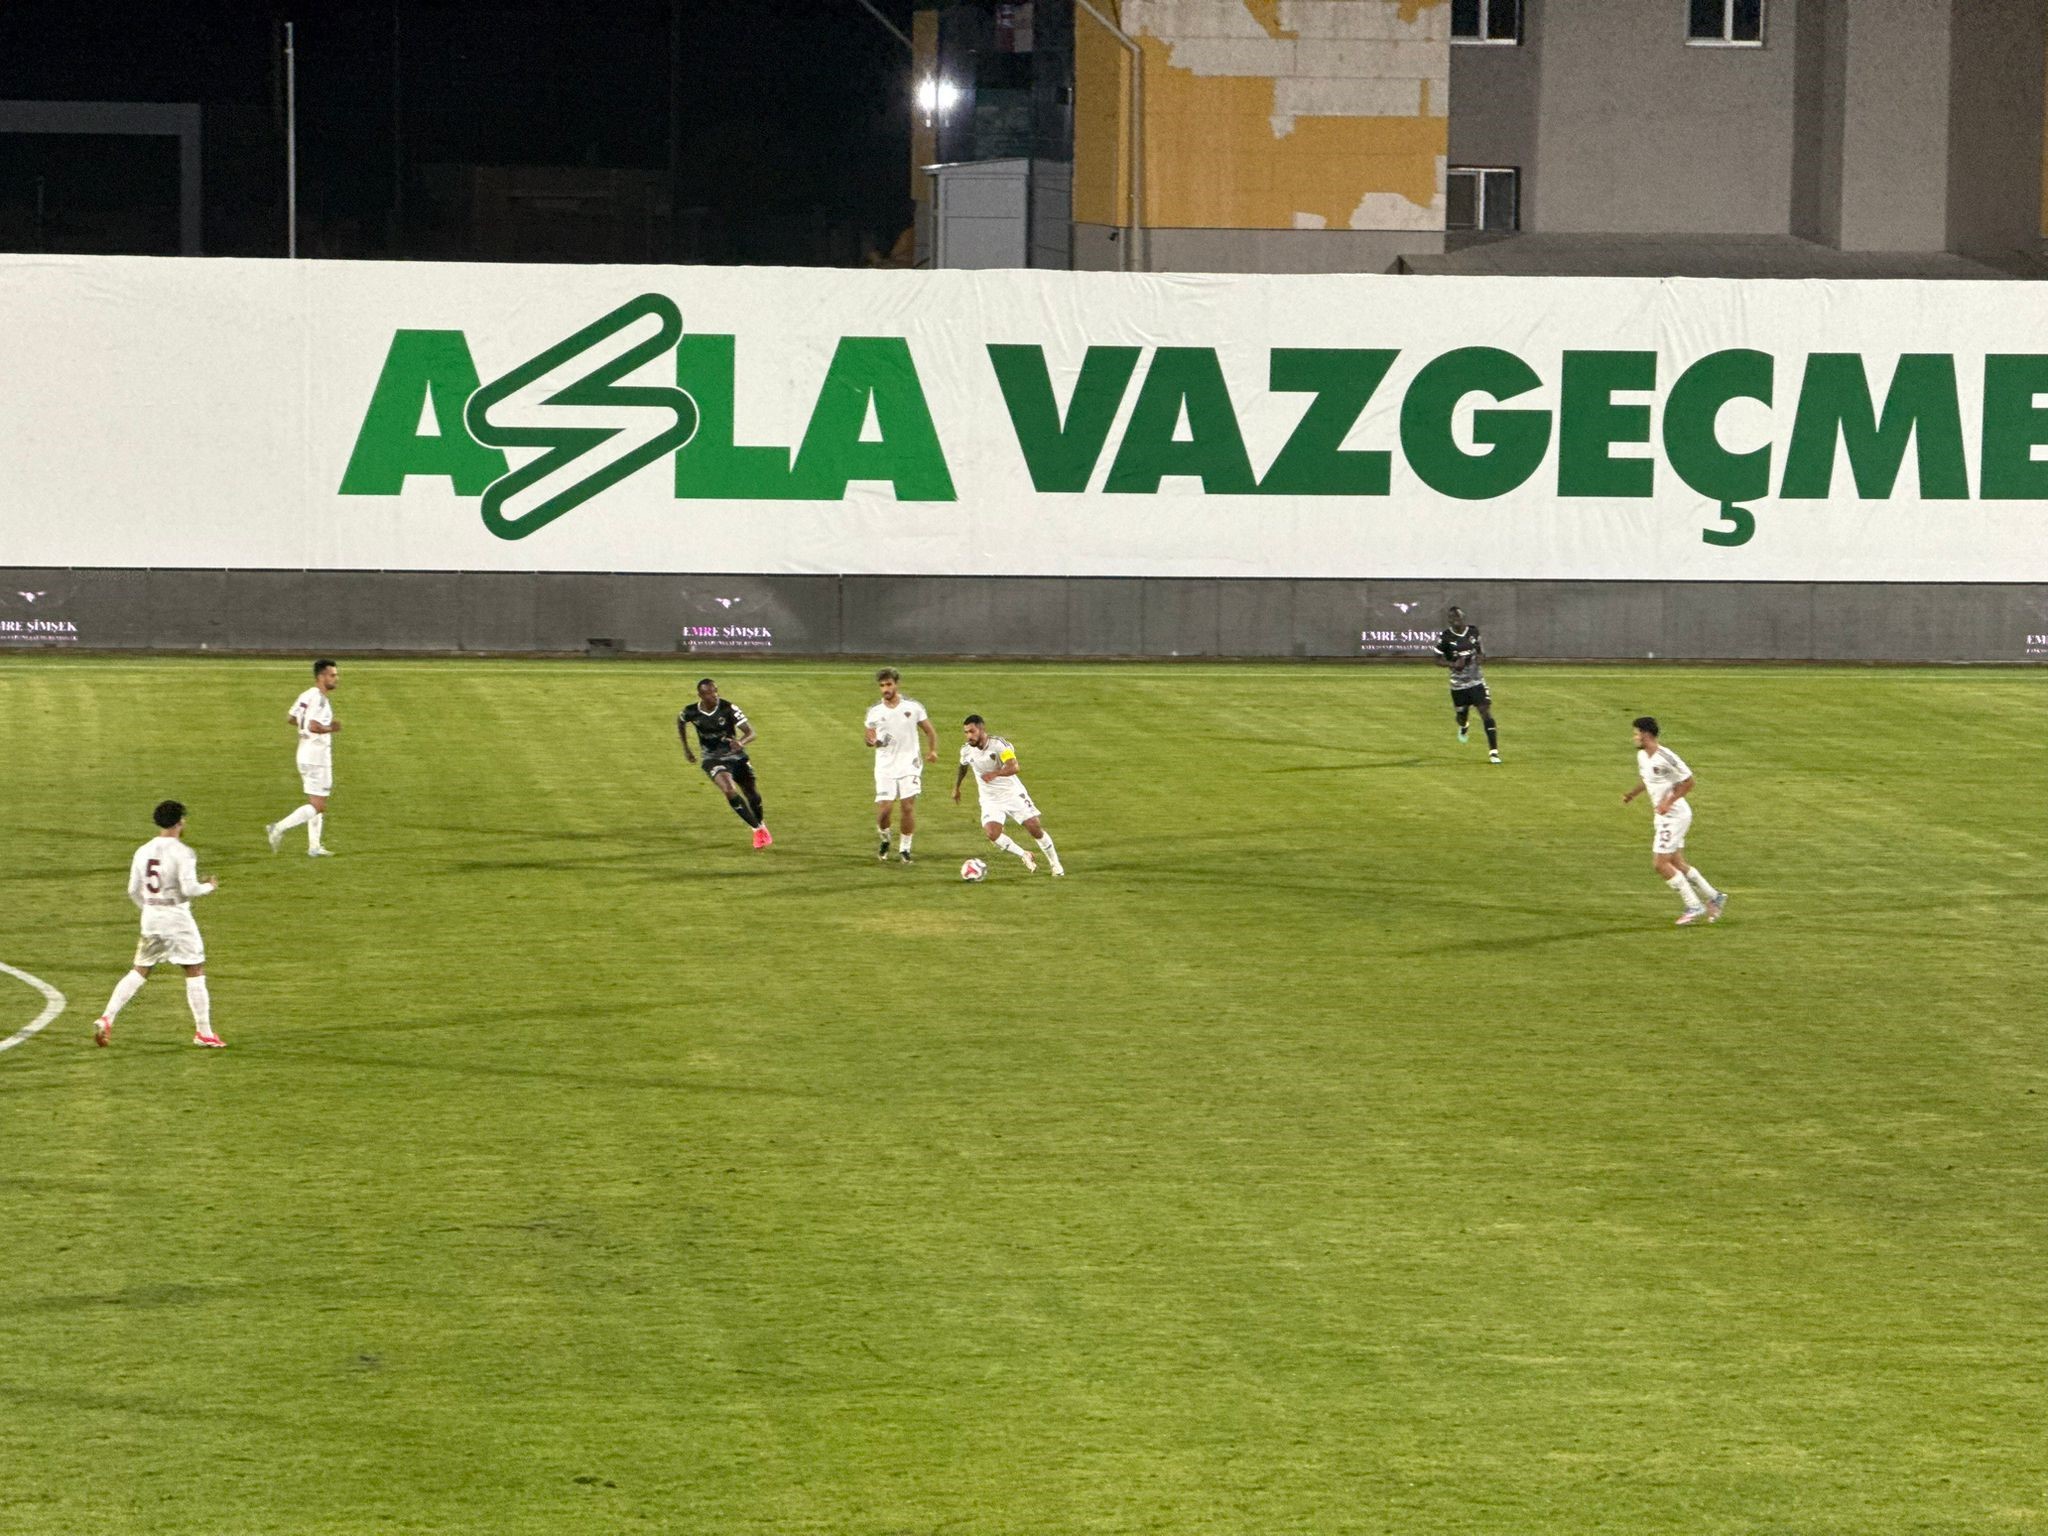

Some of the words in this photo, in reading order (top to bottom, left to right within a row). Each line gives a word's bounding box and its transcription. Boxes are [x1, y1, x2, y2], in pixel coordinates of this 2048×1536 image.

[338, 293, 958, 541] ASLA
[985, 345, 2048, 547] VAZGEÇME
[682, 626, 719, 637] EMRE
[1361, 631, 1397, 641] EMRE
[1401, 628, 1443, 642] ŞİMŞE
[2026, 634, 2048, 645] EM
[146, 858, 161, 894] 5
